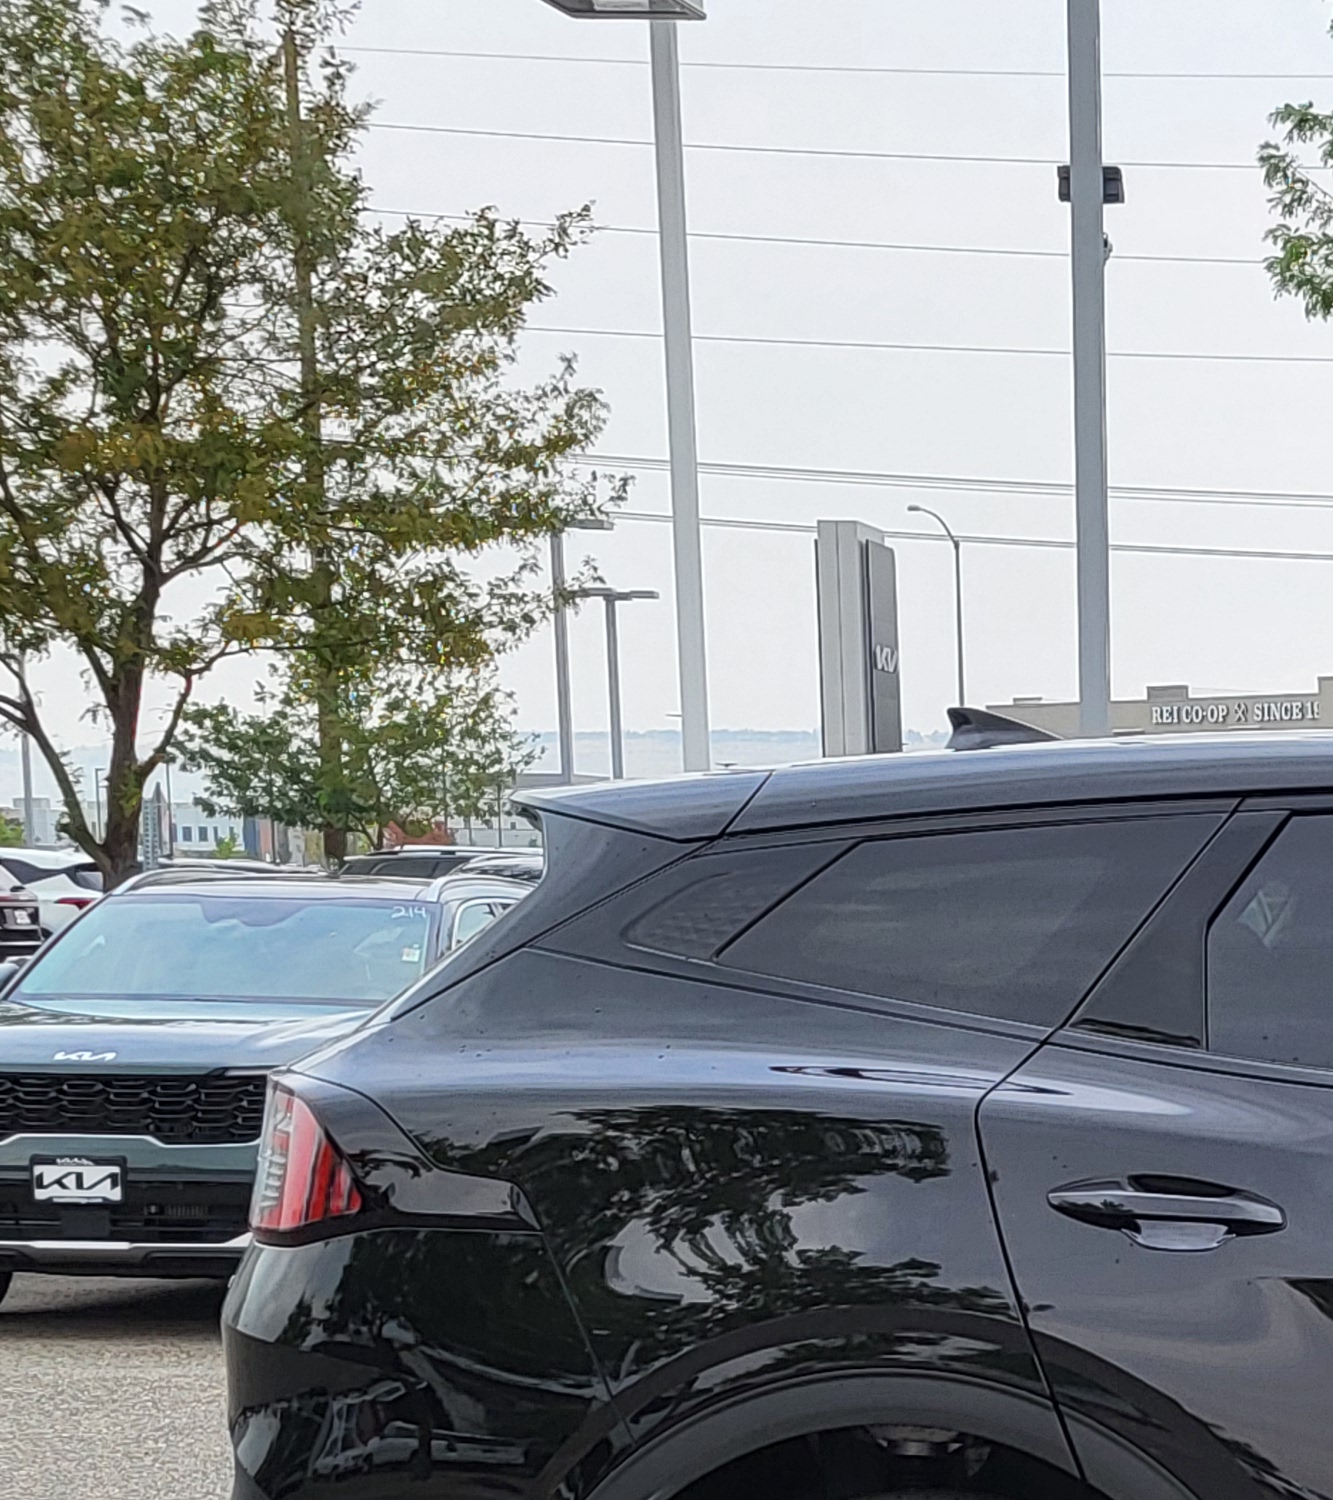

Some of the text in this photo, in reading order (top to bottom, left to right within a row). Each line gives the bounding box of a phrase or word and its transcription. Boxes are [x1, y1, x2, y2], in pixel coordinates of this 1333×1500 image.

[1151, 705, 1179, 724] REI
[1253, 702, 1302, 721] SINCE
[391, 905, 427, 919] 214
[53, 1051, 118, 1062] KIA
[35, 1171, 120, 1191] KIA
